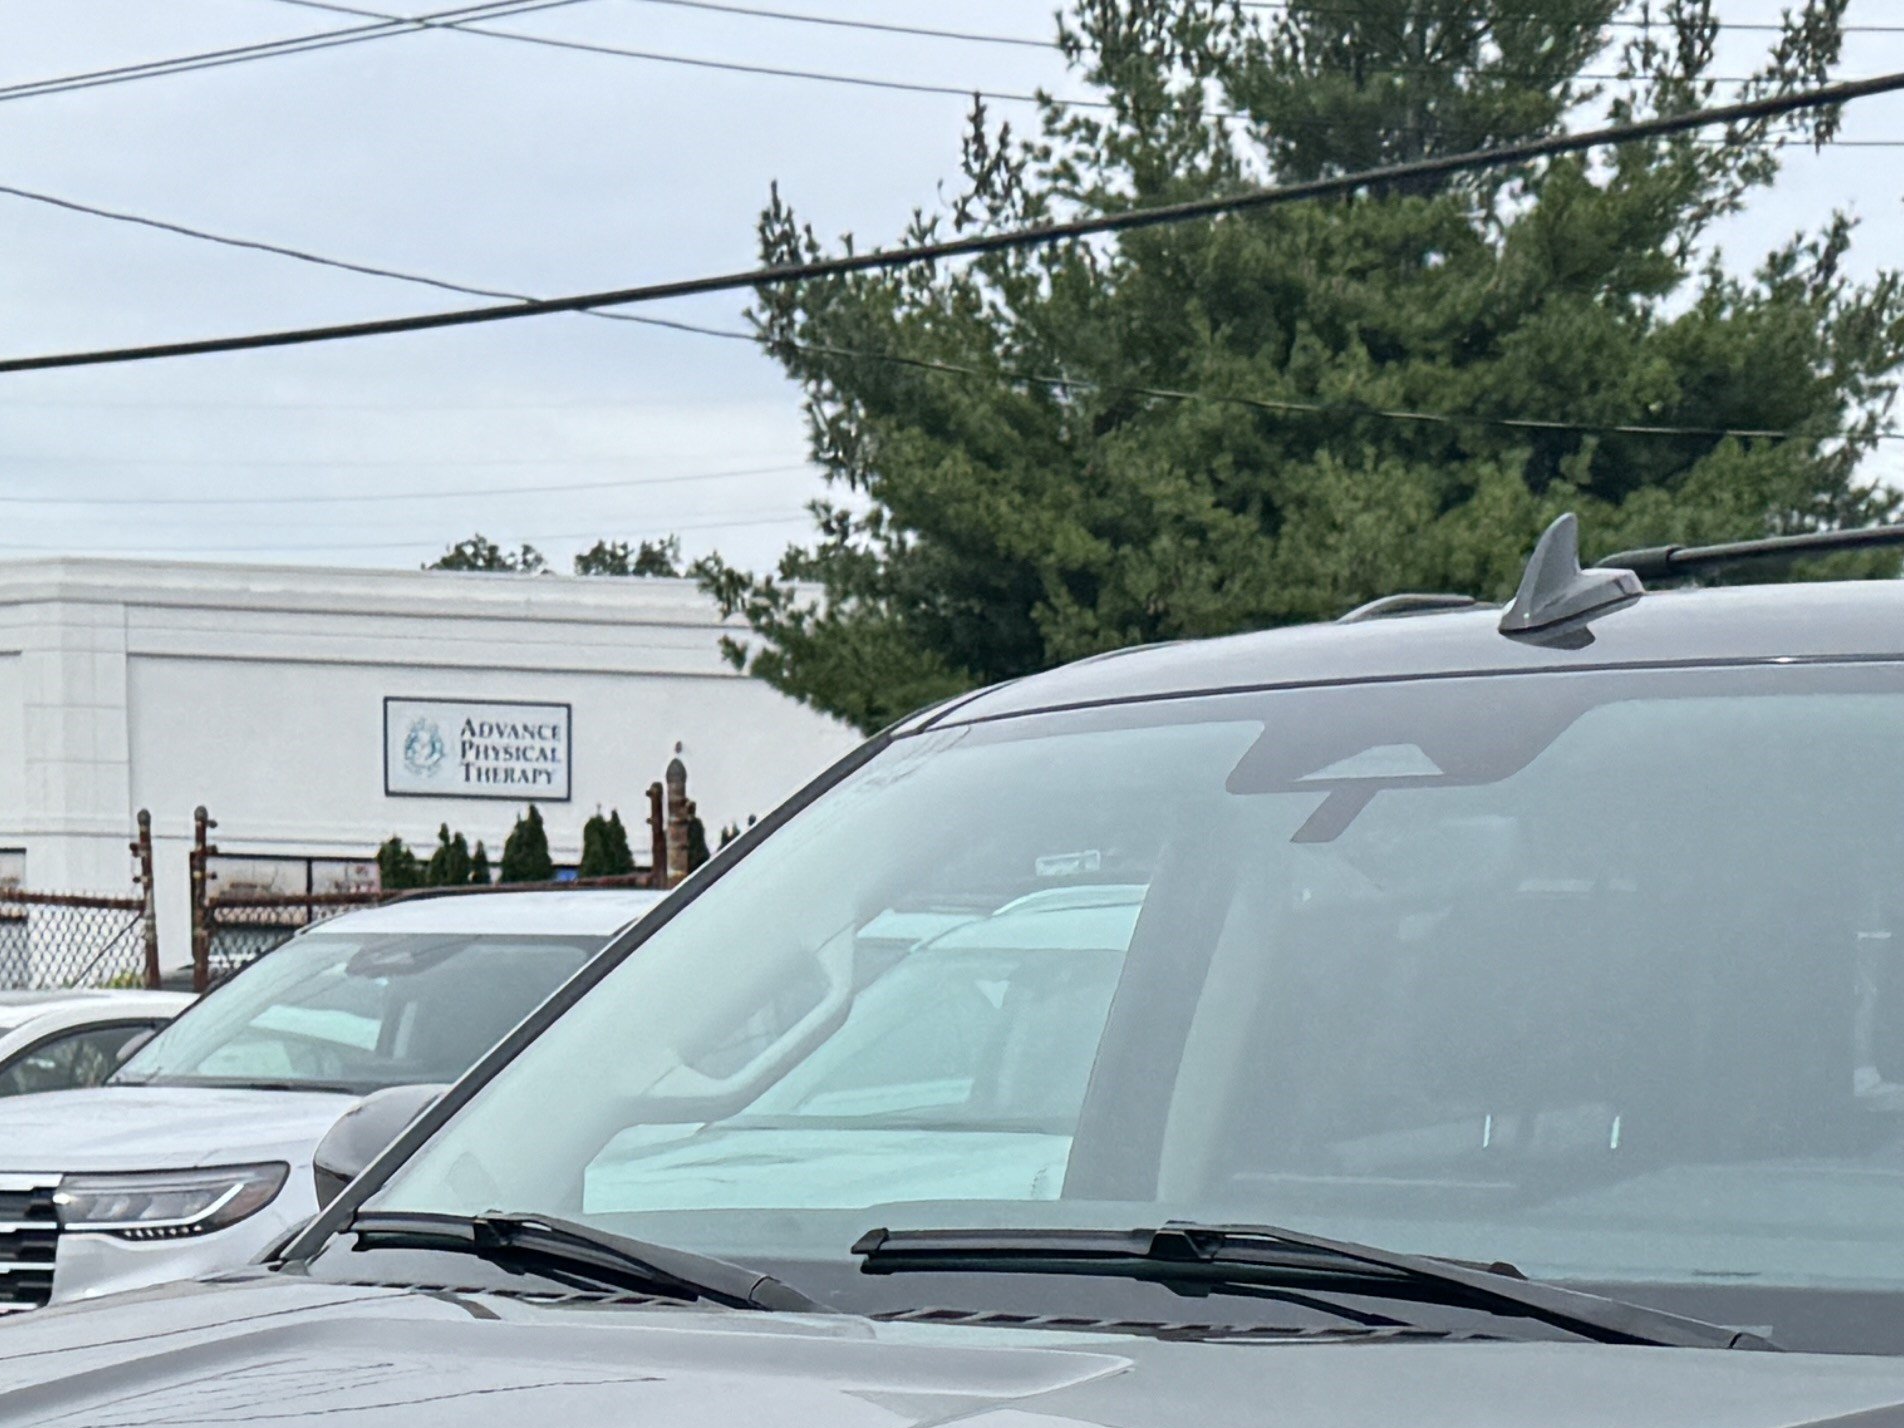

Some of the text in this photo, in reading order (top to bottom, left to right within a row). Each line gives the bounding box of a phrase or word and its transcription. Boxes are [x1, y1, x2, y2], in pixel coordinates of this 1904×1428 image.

[460, 718, 561, 741] ADVANCE
[460, 740, 561, 763] PHYSICAL
[460, 761, 554, 785] THERAPY
